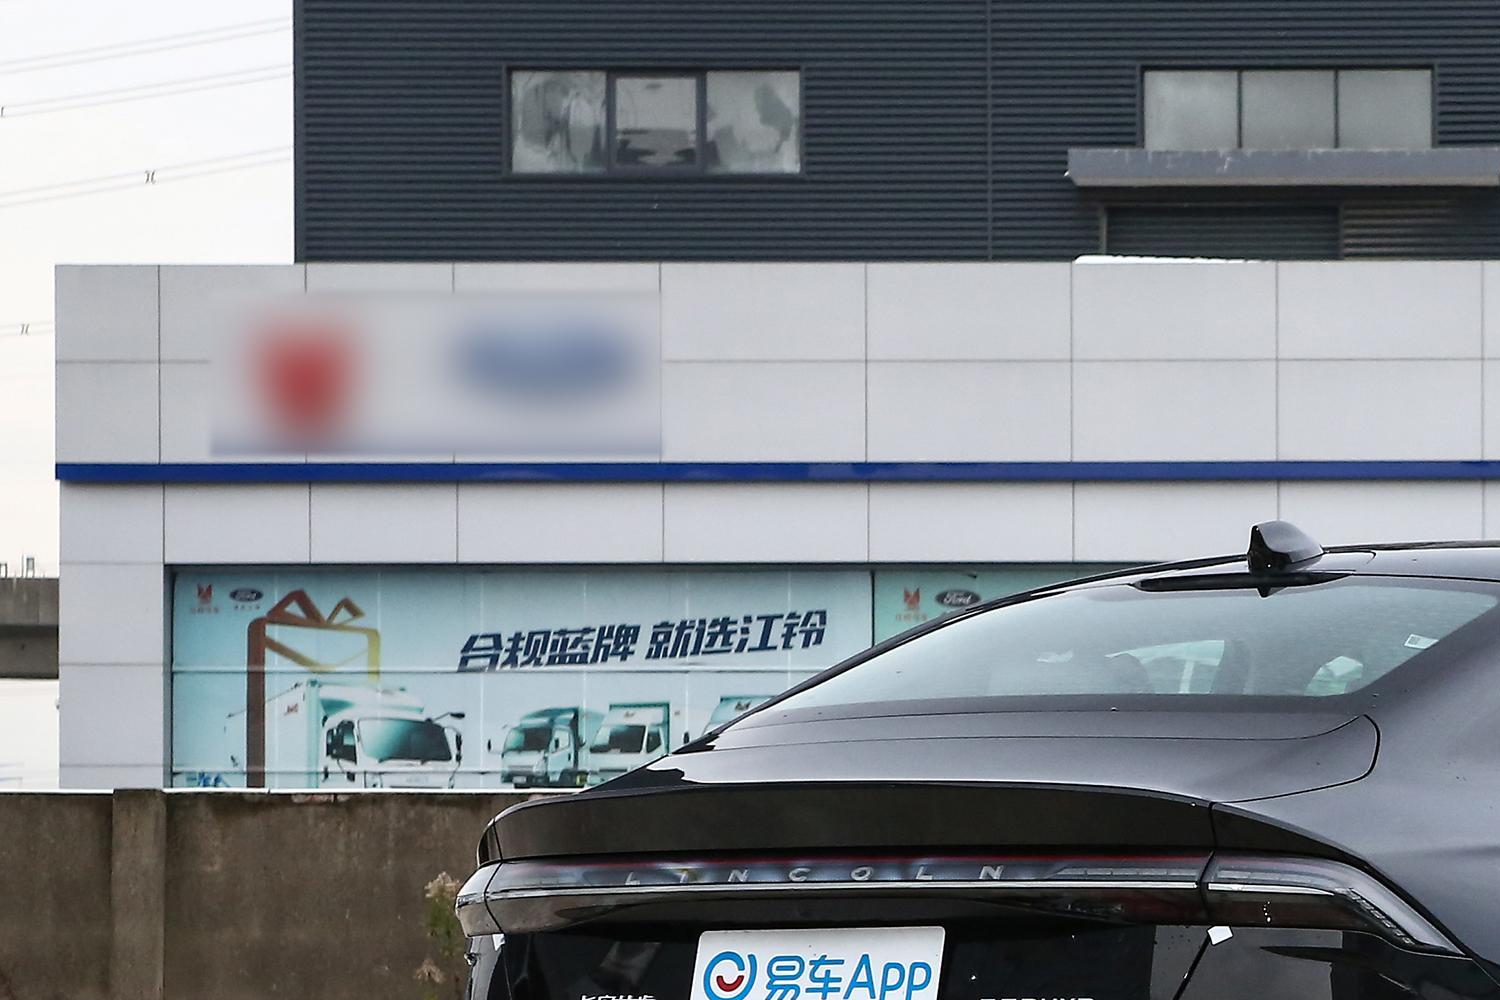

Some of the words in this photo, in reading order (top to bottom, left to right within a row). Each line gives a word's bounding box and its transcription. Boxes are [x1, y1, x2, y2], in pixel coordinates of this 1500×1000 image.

[457, 625, 640, 672] 合规蓝牌
[645, 610, 827, 659] 就选江铃
[625, 865, 1004, 886] LINCOLN
